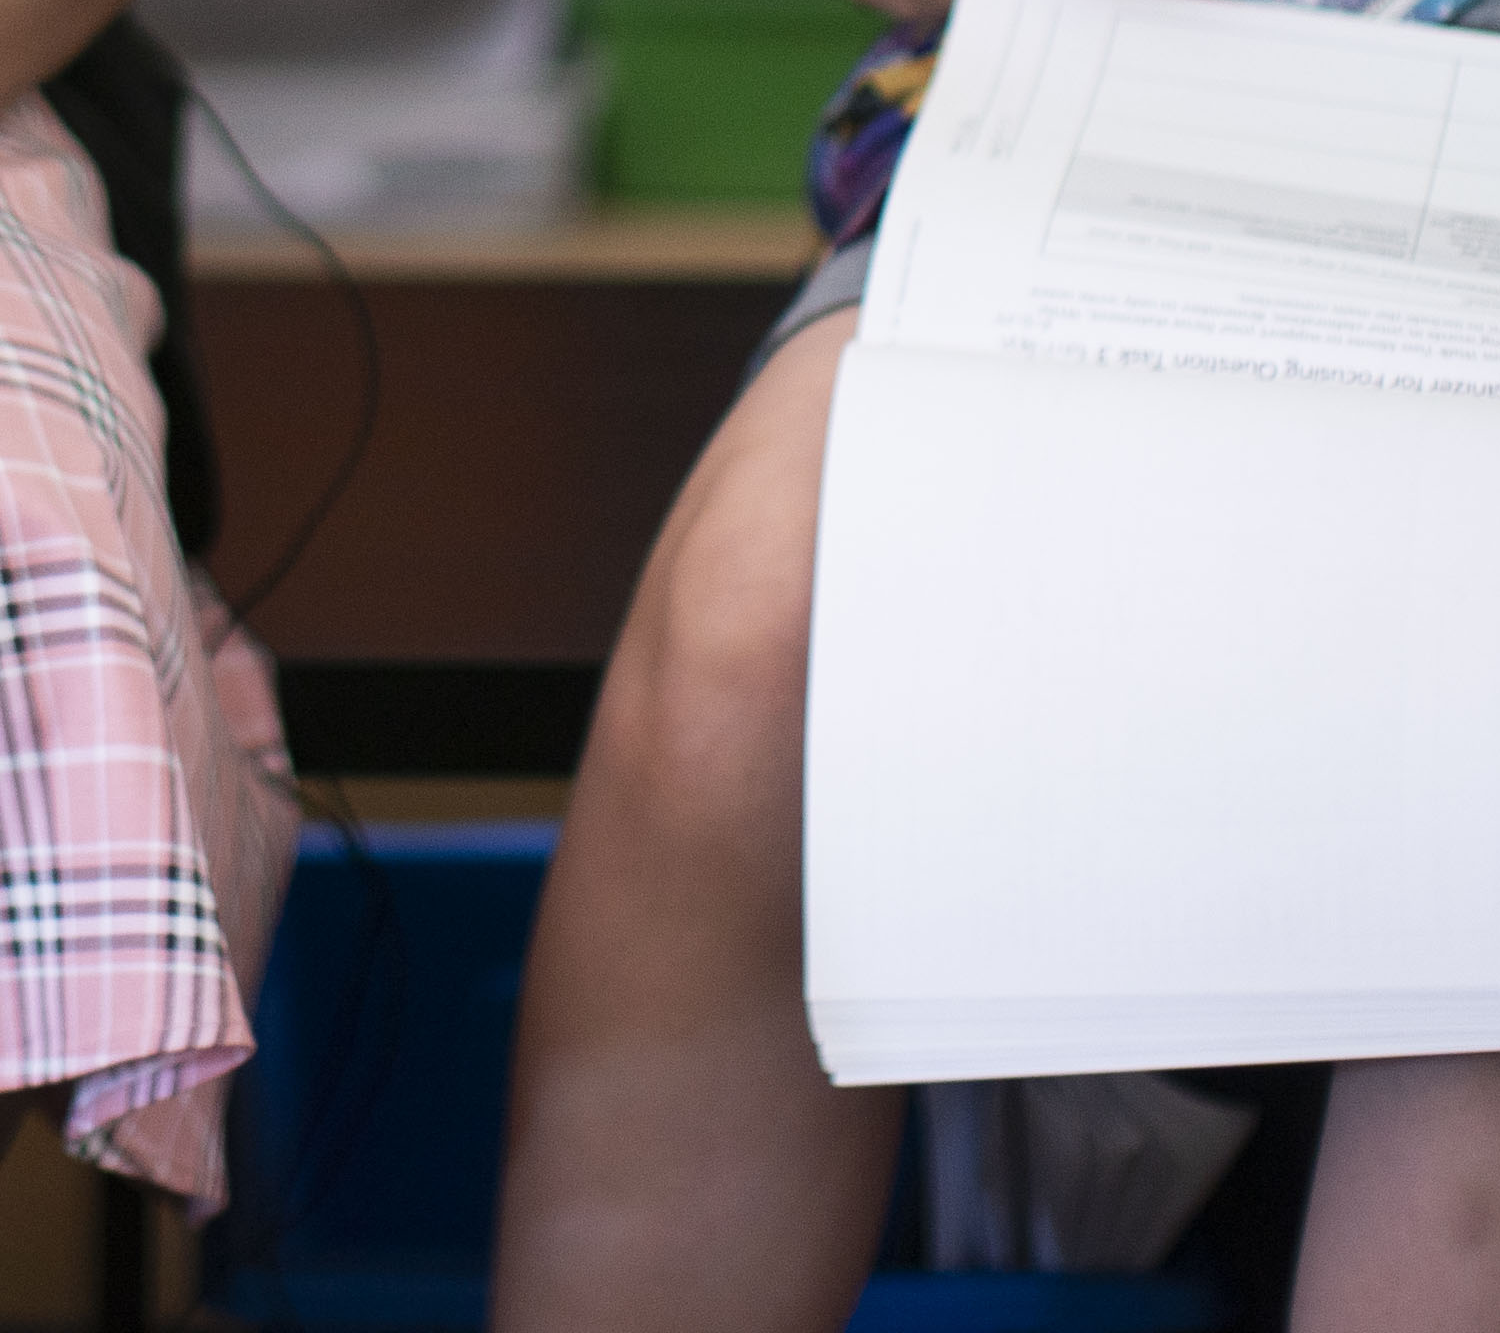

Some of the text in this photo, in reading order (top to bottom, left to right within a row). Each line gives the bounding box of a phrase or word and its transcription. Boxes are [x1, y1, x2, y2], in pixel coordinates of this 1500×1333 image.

[1175, 353, 1278, 382] Question
[1286, 359, 1386, 390] Focusing
[1392, 374, 1424, 393] for
